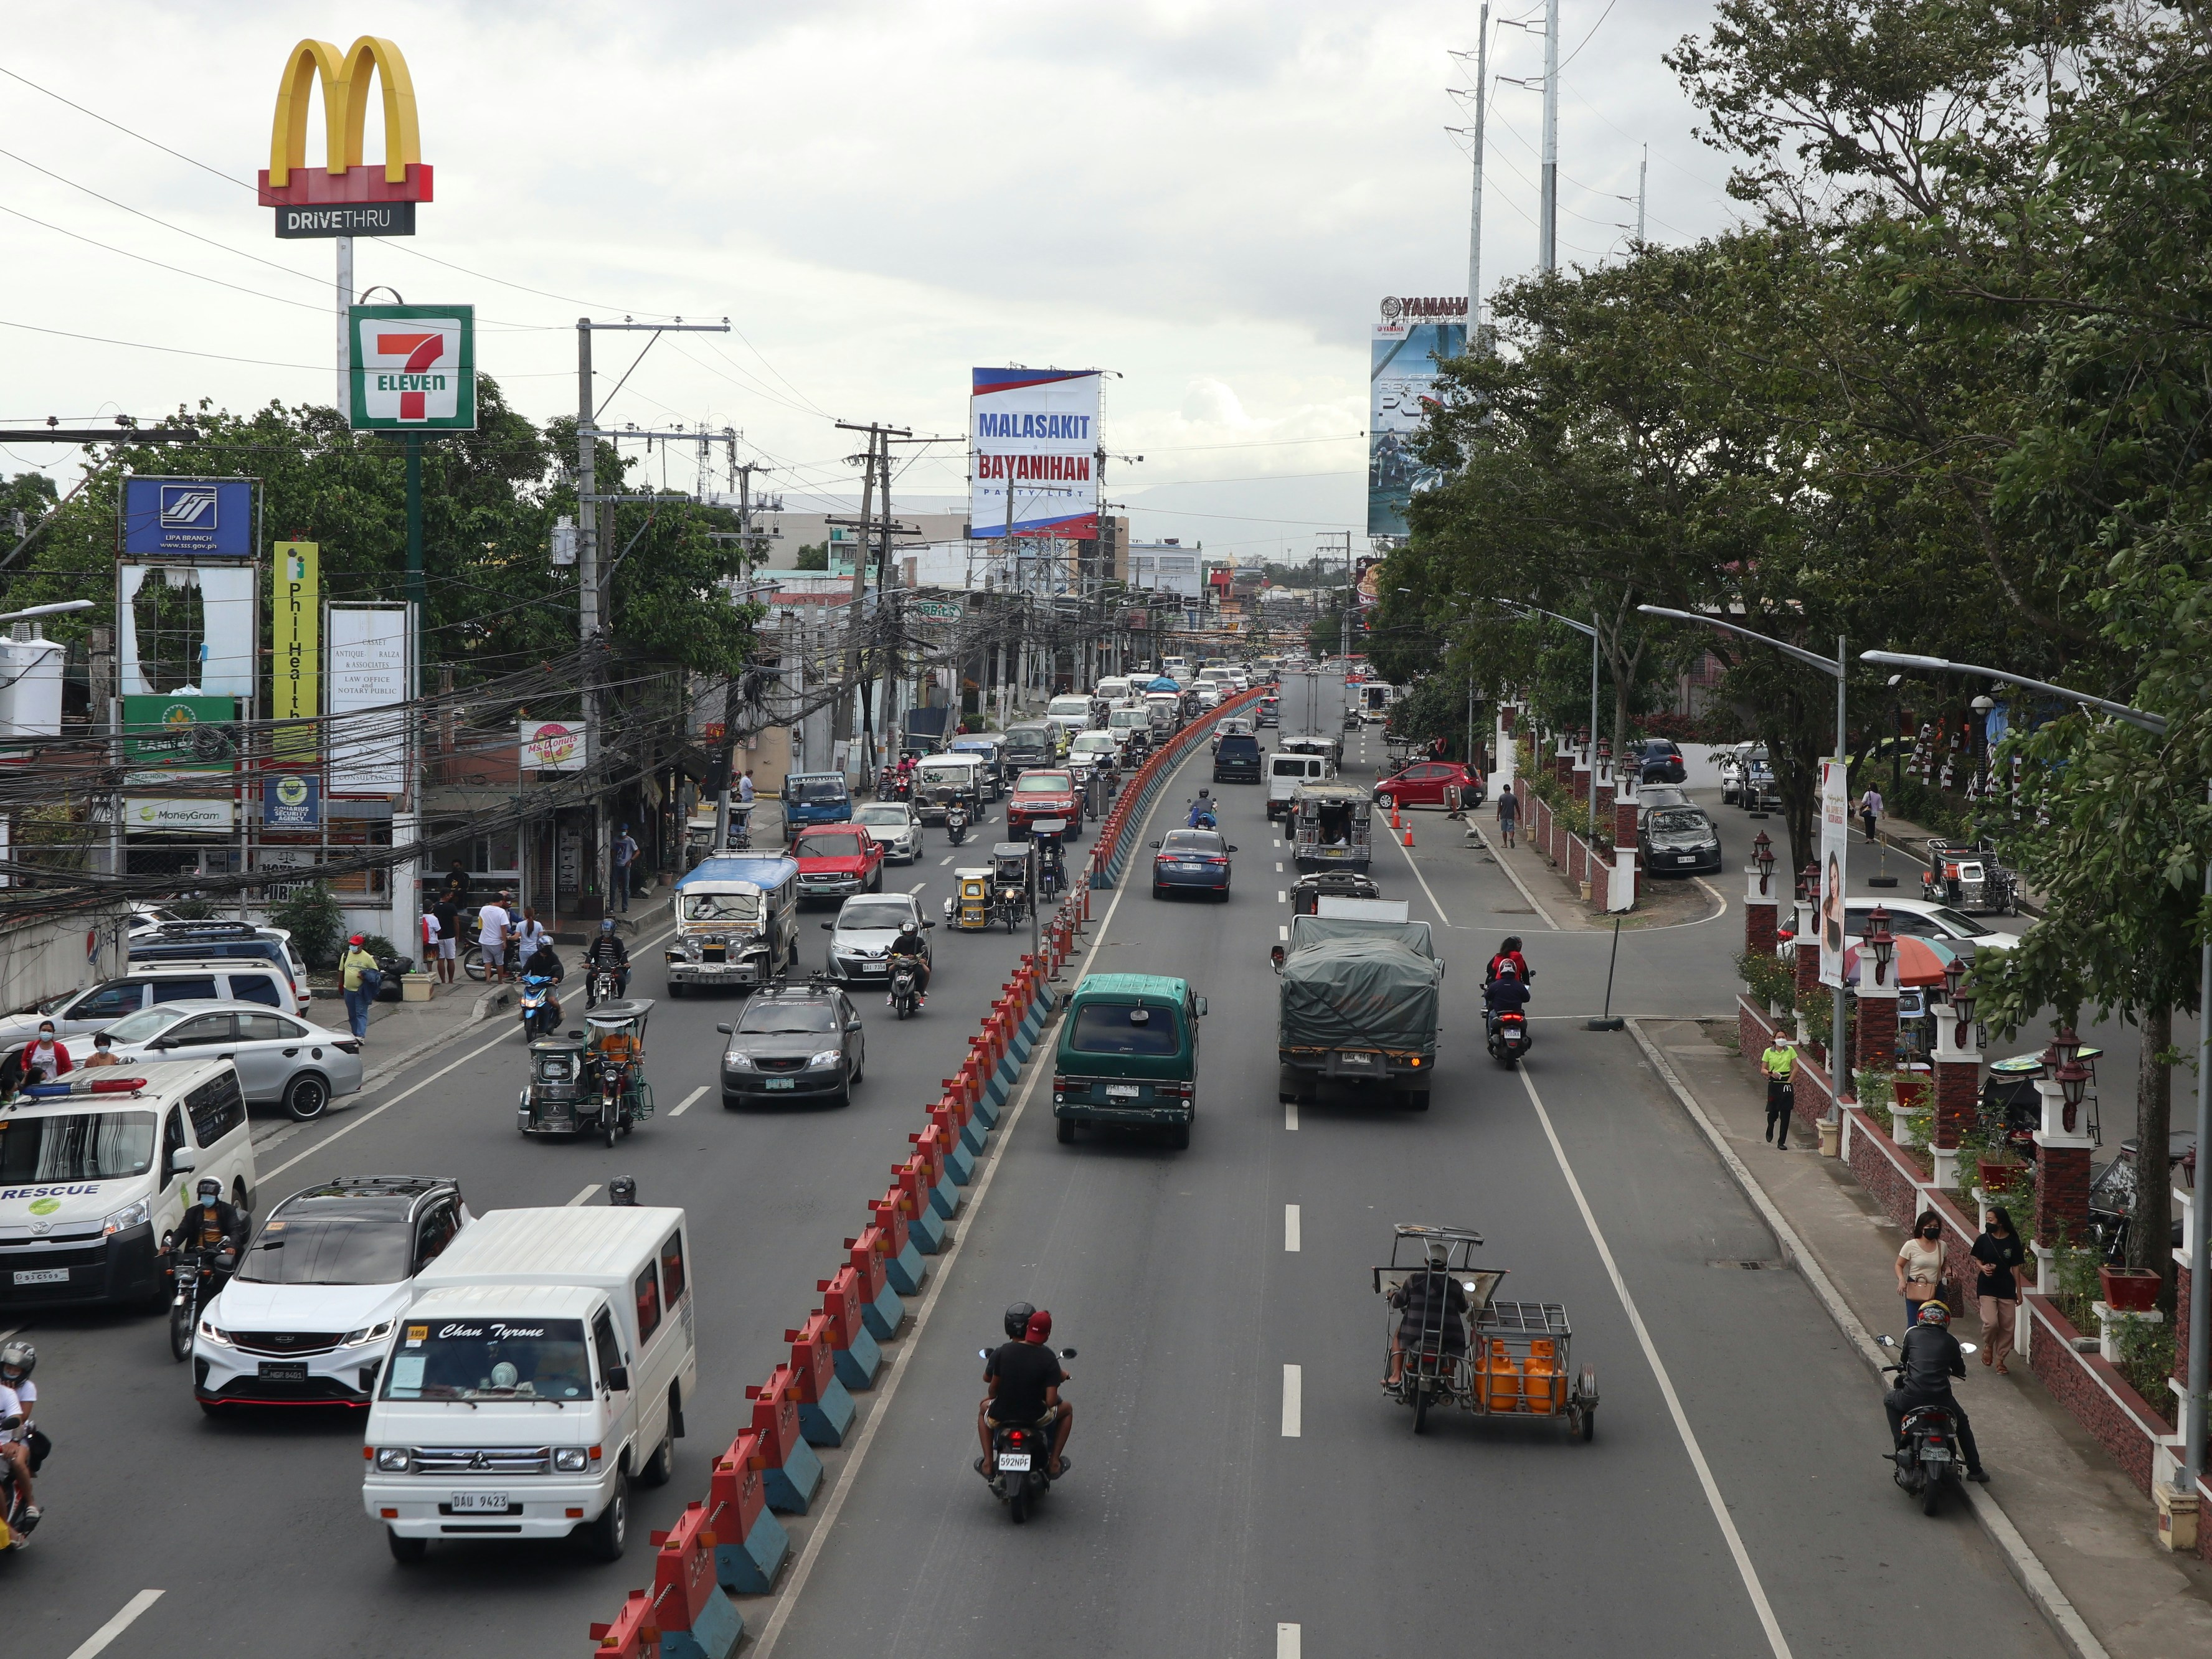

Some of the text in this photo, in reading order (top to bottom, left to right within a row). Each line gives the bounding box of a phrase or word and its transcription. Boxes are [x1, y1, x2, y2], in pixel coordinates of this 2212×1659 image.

[980, 414, 1090, 438] MALASAKIT
[979, 455, 1089, 481] BAYANIHAN
[289, 582, 301, 719] PhilHealth
[158, 811, 219, 821] MoneyGram
[1, 1184, 100, 1200] RESCUE
[438, 1323, 483, 1339] Chan
[489, 1323, 545, 1340] Tyrone
[1001, 1457, 1029, 1467] 592NPF
[480, 1496, 506, 1507] 9423
